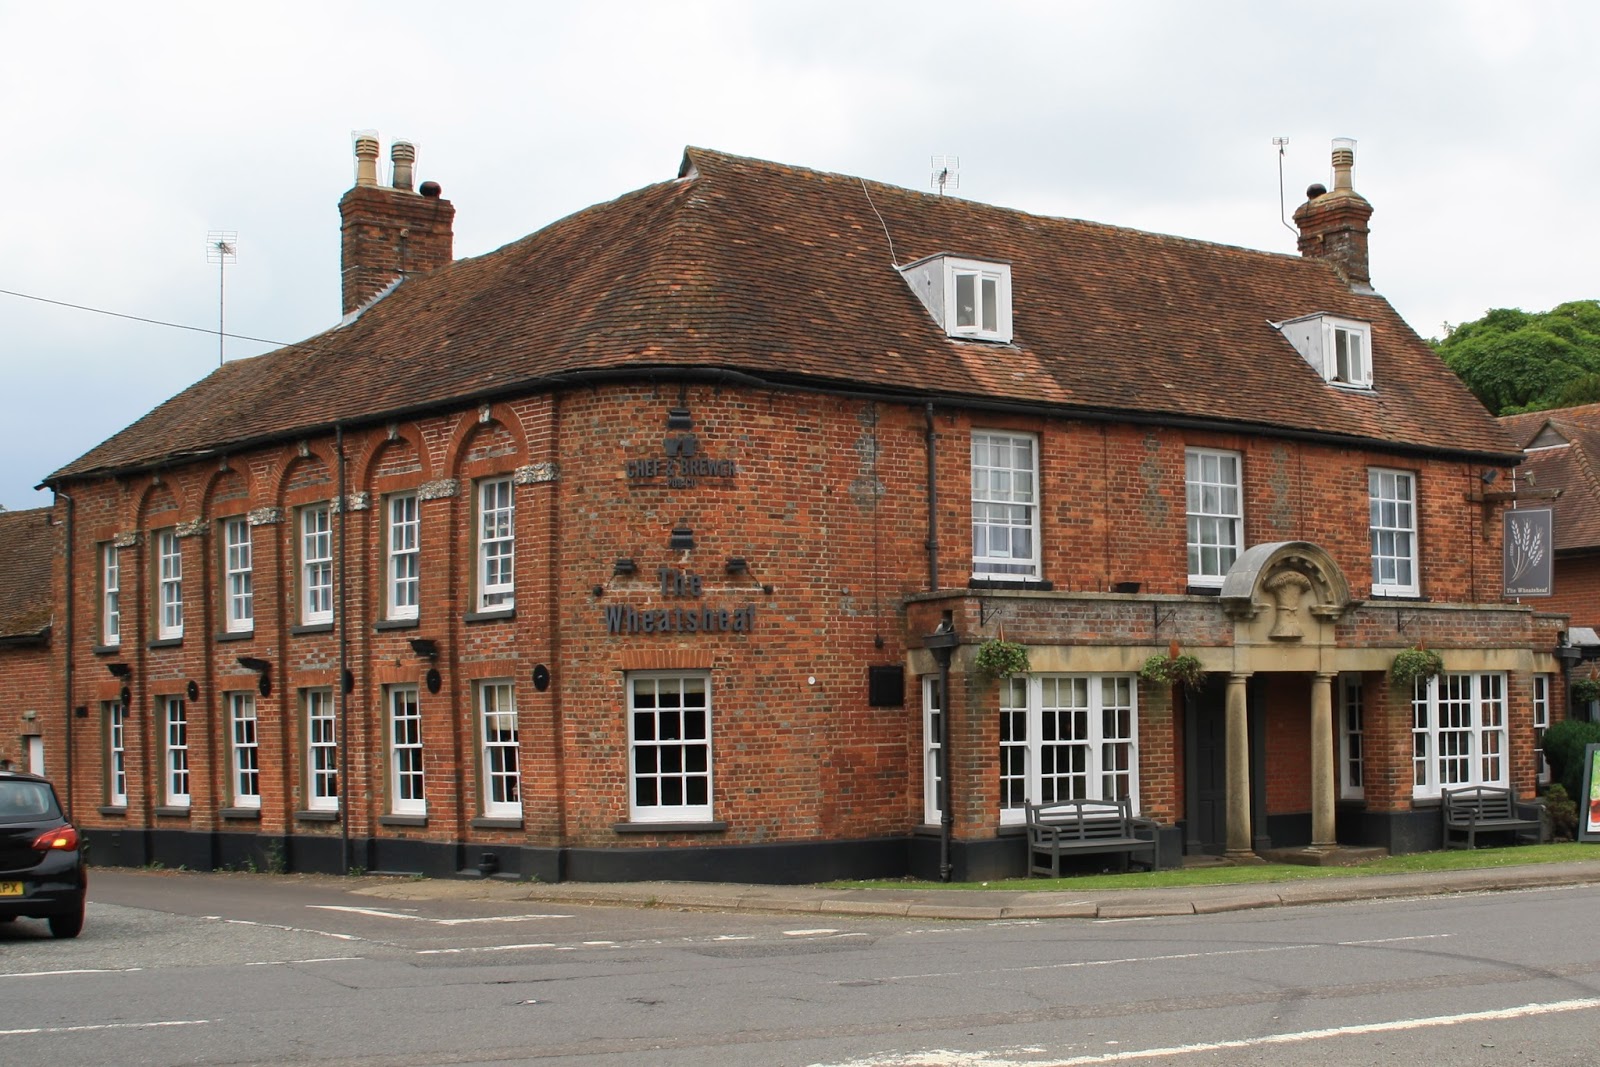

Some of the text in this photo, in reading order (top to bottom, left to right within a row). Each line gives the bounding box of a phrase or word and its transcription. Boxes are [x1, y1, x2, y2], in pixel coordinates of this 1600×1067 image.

[627, 459, 736, 477] CHEF & BREWER
[659, 567, 702, 597] The
[605, 603, 756, 633] Wheatsheaf
